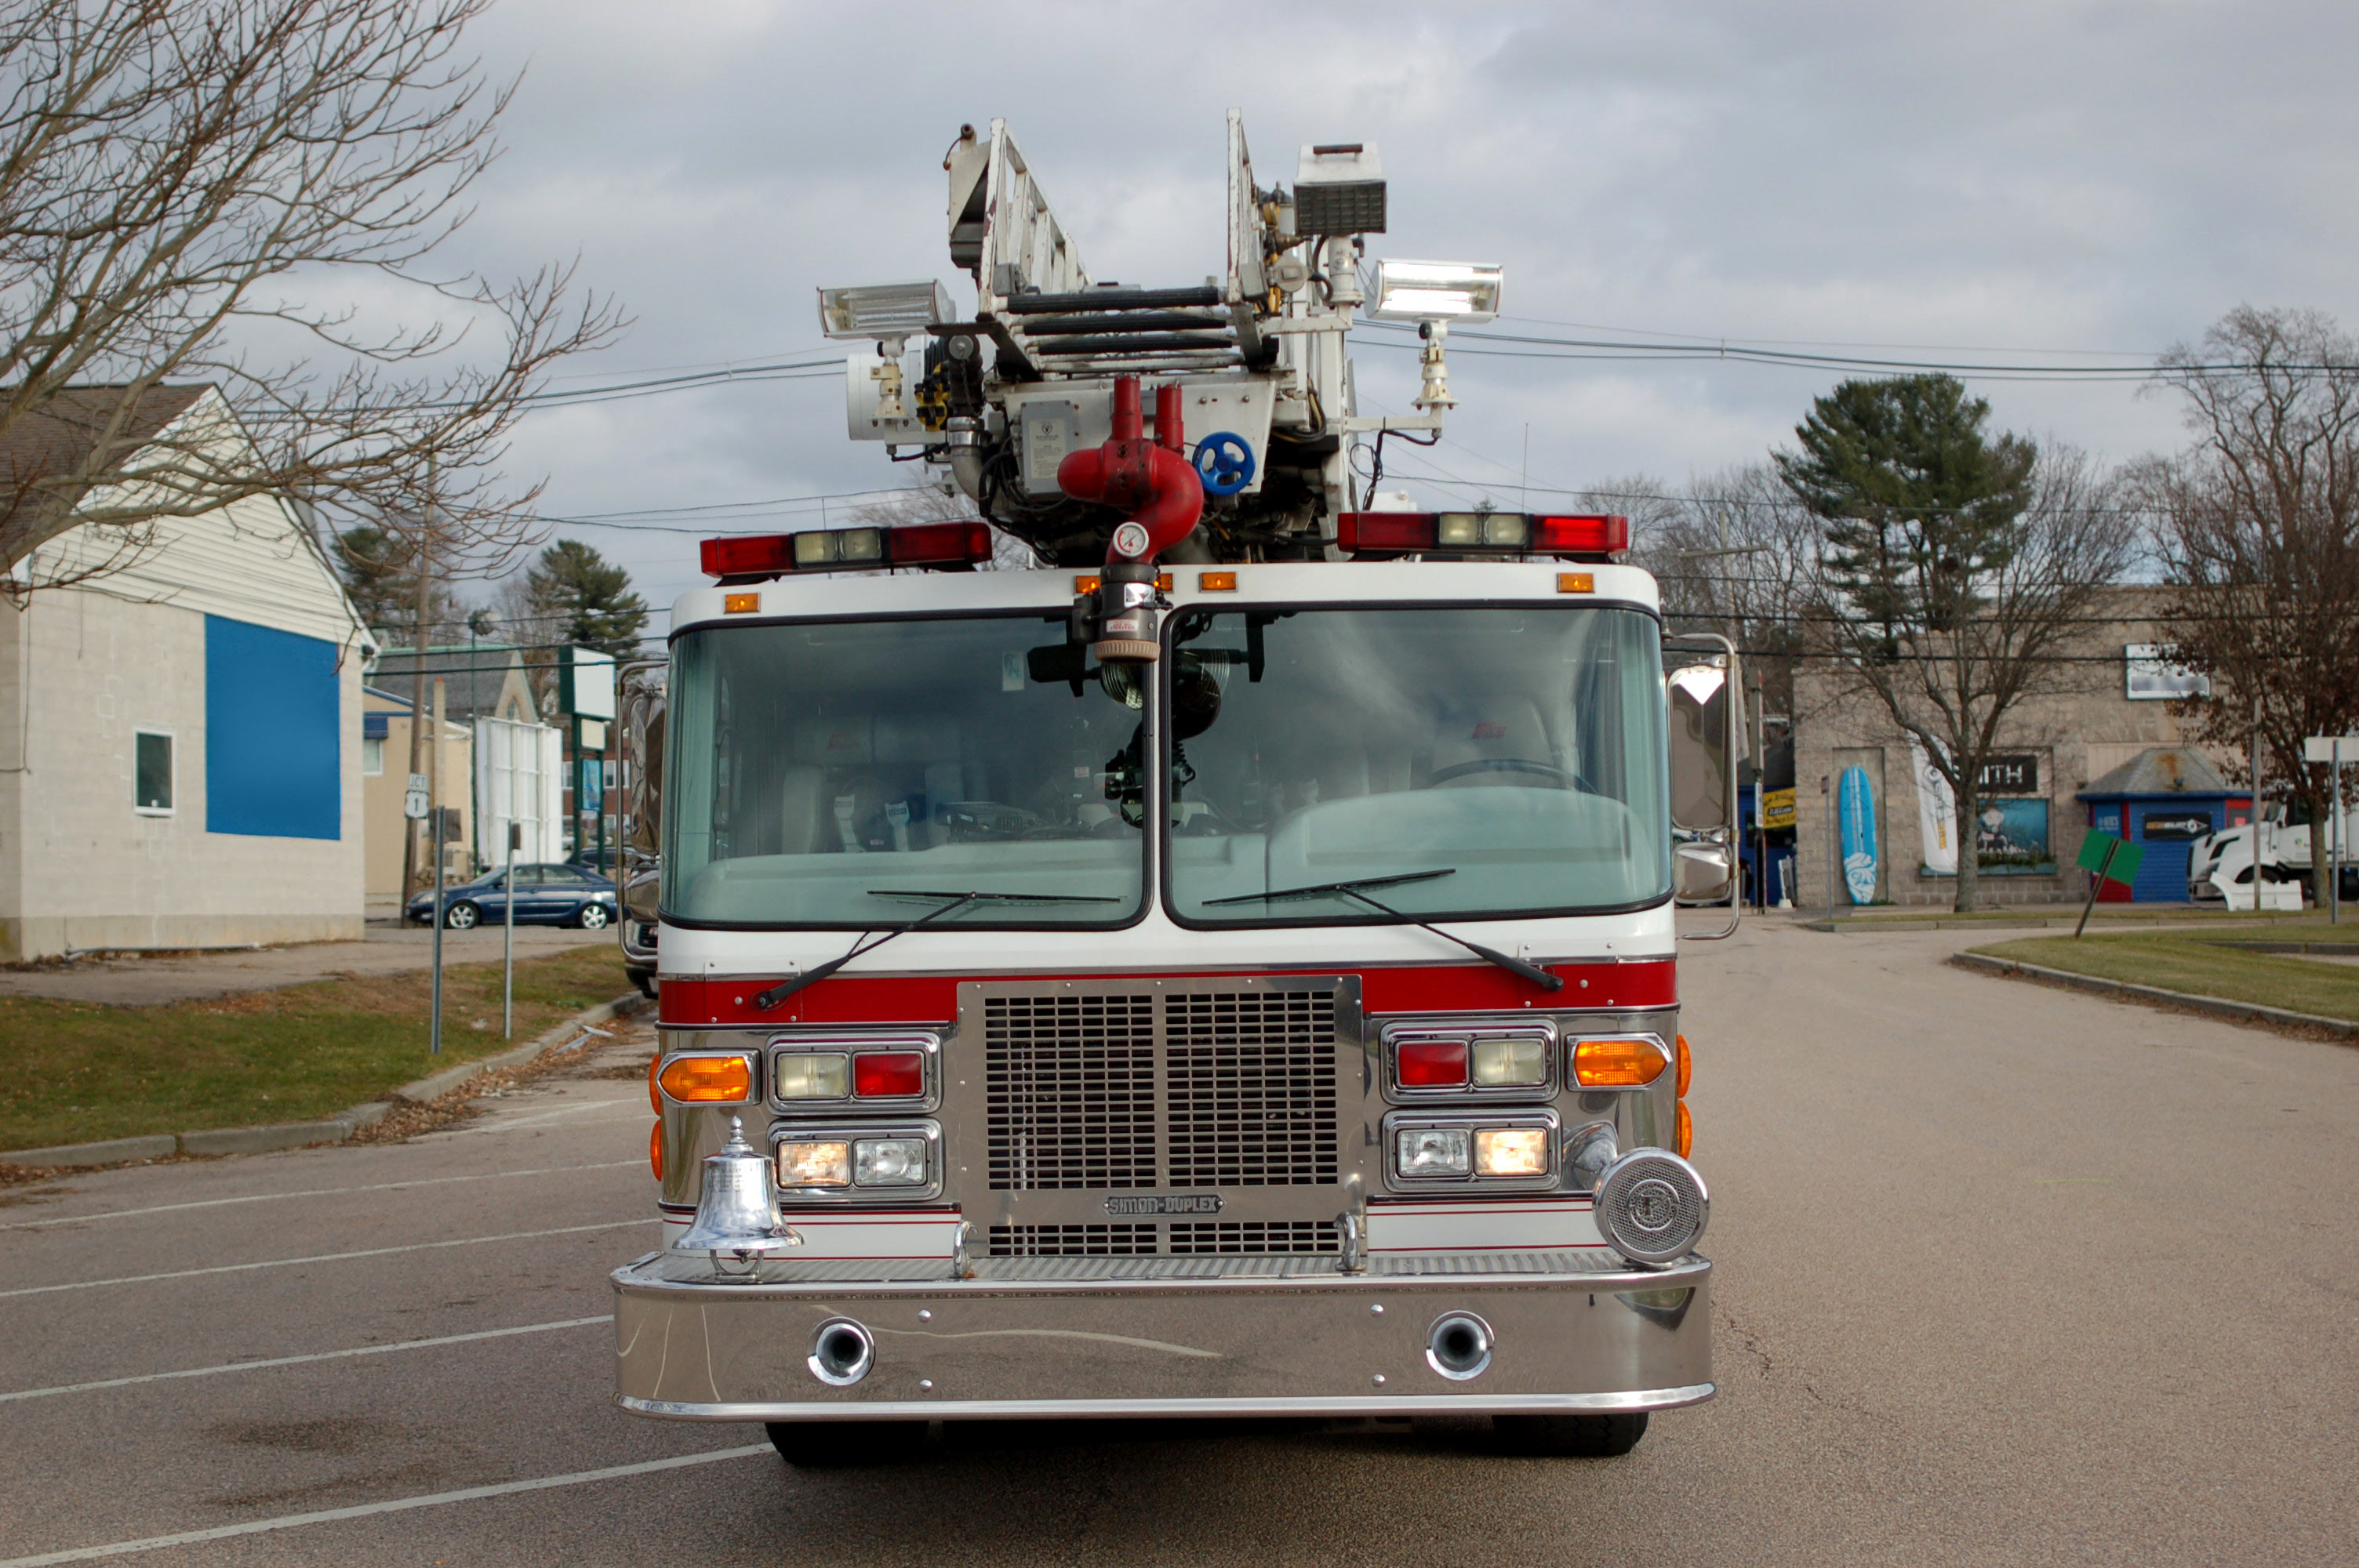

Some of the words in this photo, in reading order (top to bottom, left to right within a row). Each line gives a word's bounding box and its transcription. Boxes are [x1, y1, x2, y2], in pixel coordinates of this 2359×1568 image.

[410, 776, 425, 787] JCT
[414, 797, 418, 811] 1
[1108, 1196, 1217, 1214] SIMON-DUPLEX
